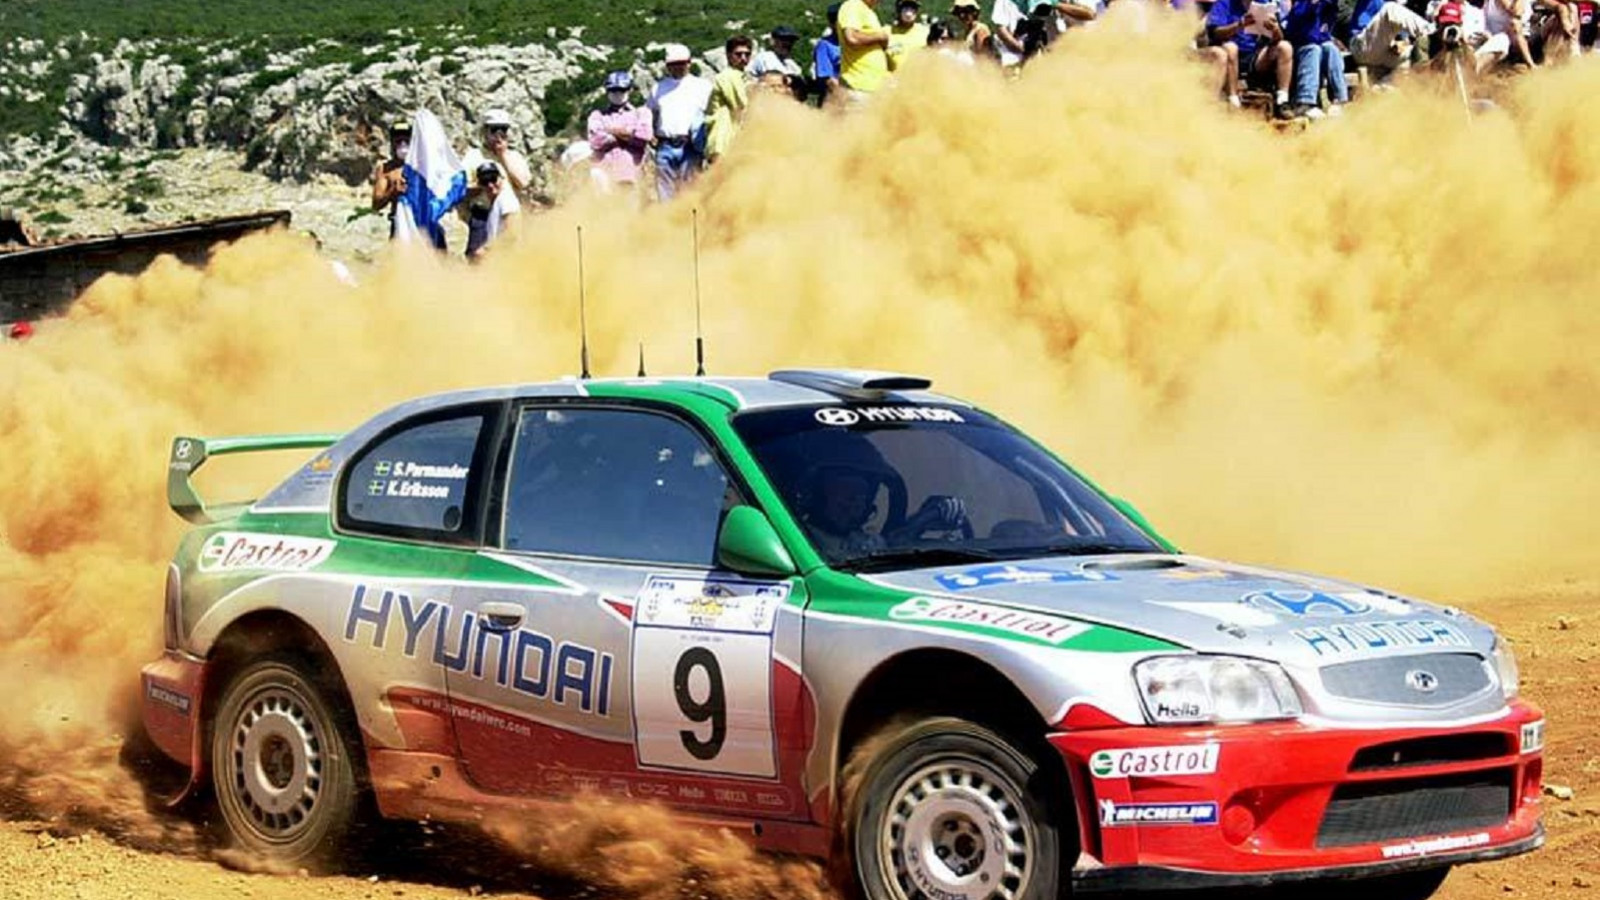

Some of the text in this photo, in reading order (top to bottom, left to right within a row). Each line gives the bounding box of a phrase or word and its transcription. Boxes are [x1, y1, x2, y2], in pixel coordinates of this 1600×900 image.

[857, 406, 966, 423] HYUNDAI
[222, 537, 323, 568] Castrol
[929, 603, 1065, 638] Castrol
[344, 582, 613, 717] HYUNDAI
[1291, 621, 1472, 655] HYUNDAI
[674, 646, 727, 761] 9
[1157, 703, 1200, 718] Hella
[1118, 748, 1211, 775] Castrol
[1116, 806, 1214, 820] MICHELIN
